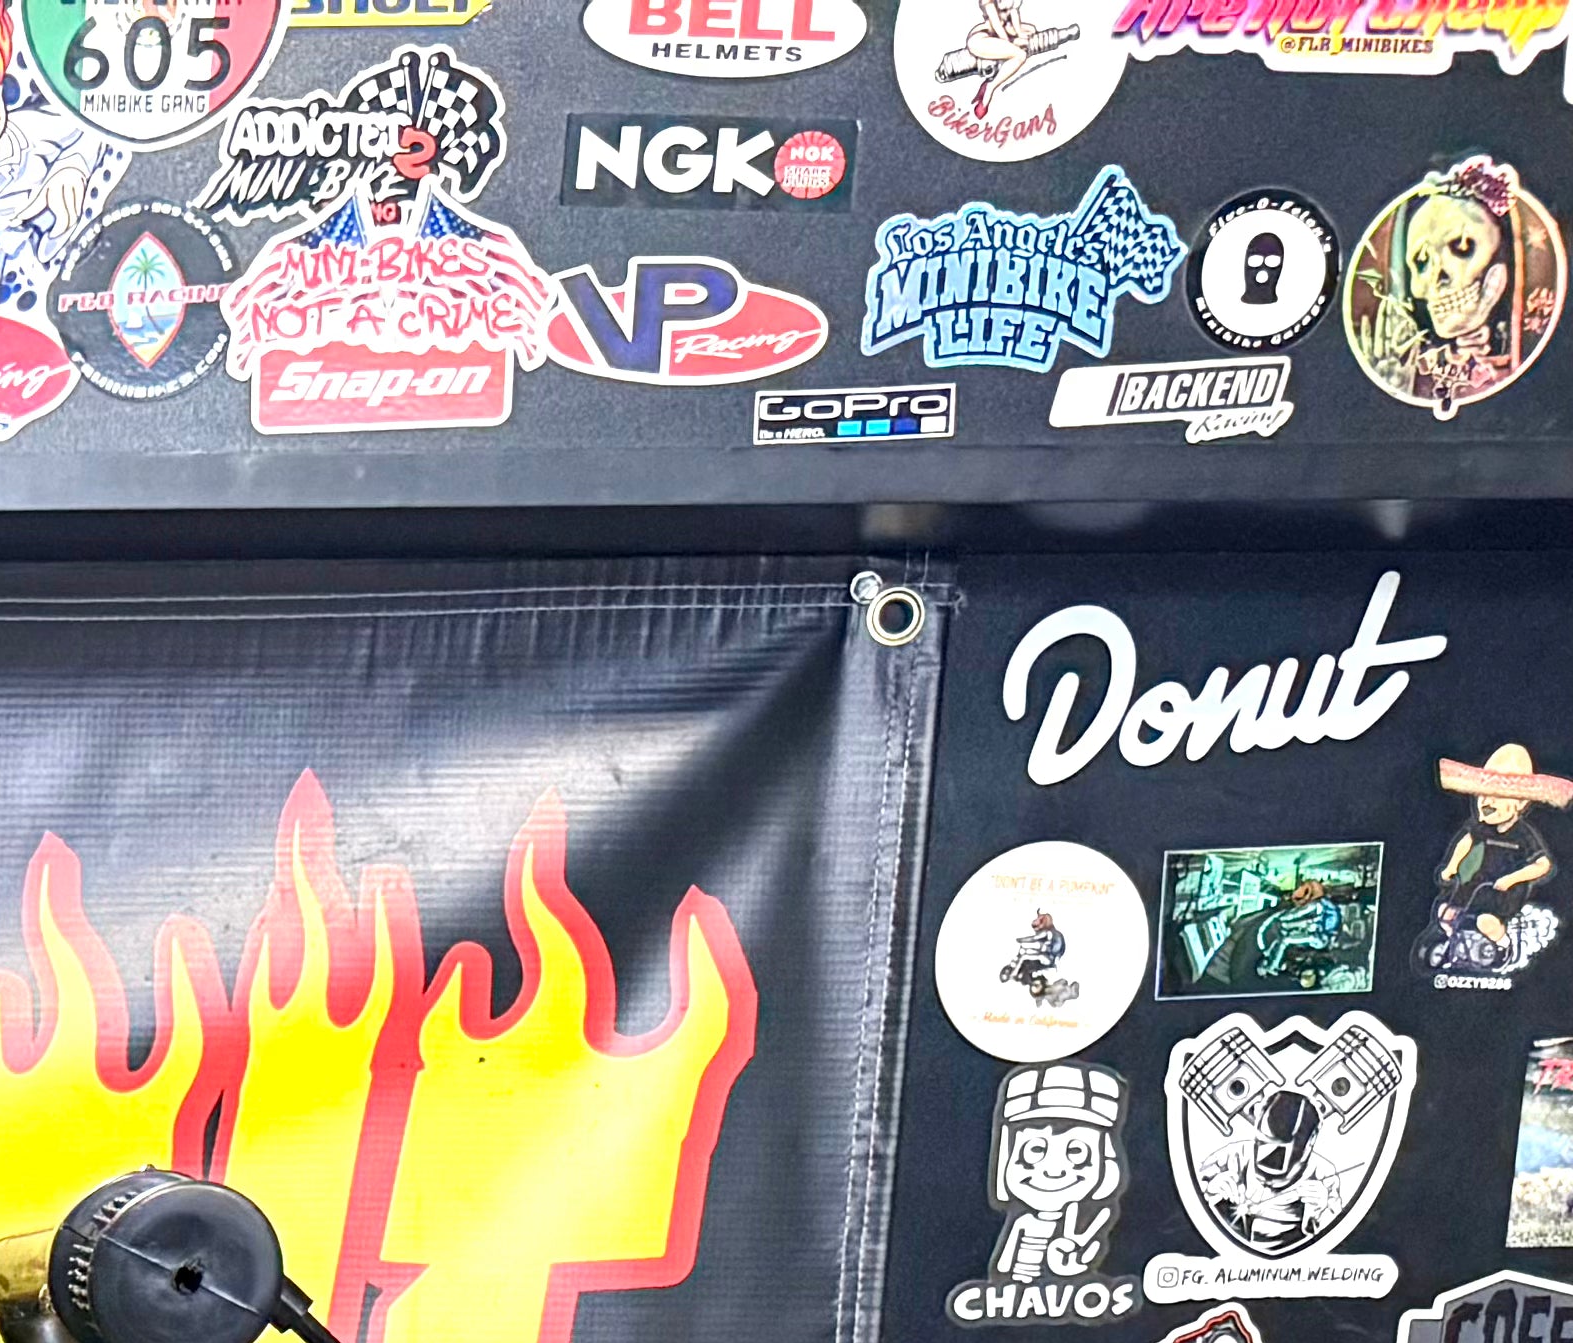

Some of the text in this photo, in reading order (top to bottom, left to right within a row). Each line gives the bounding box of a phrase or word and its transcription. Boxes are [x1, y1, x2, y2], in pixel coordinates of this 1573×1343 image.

[64, 17, 231, 91] 605
[652, 42, 802, 62] HELMETS
[83, 94, 207, 114] MINIBIKE GANG
[392, 126, 437, 180] 2
[576, 124, 775, 196] NGK
[790, 146, 834, 161] NGK
[370, 237, 489, 282] BIKES
[887, 214, 1105, 267] Los Angeles
[876, 249, 1112, 341] MINIBIKE
[253, 297, 518, 341] NOT A CRIME
[559, 264, 738, 373] VP
[935, 308, 1058, 359] LIFE
[675, 329, 823, 363] Racing
[270, 360, 491, 406] Snap-on
[1120, 368, 1278, 412] BACKEND
[759, 394, 948, 421] GoPro
[1002, 569, 1449, 786] Donut
[953, 1282, 1134, 1320] CHAVOS
